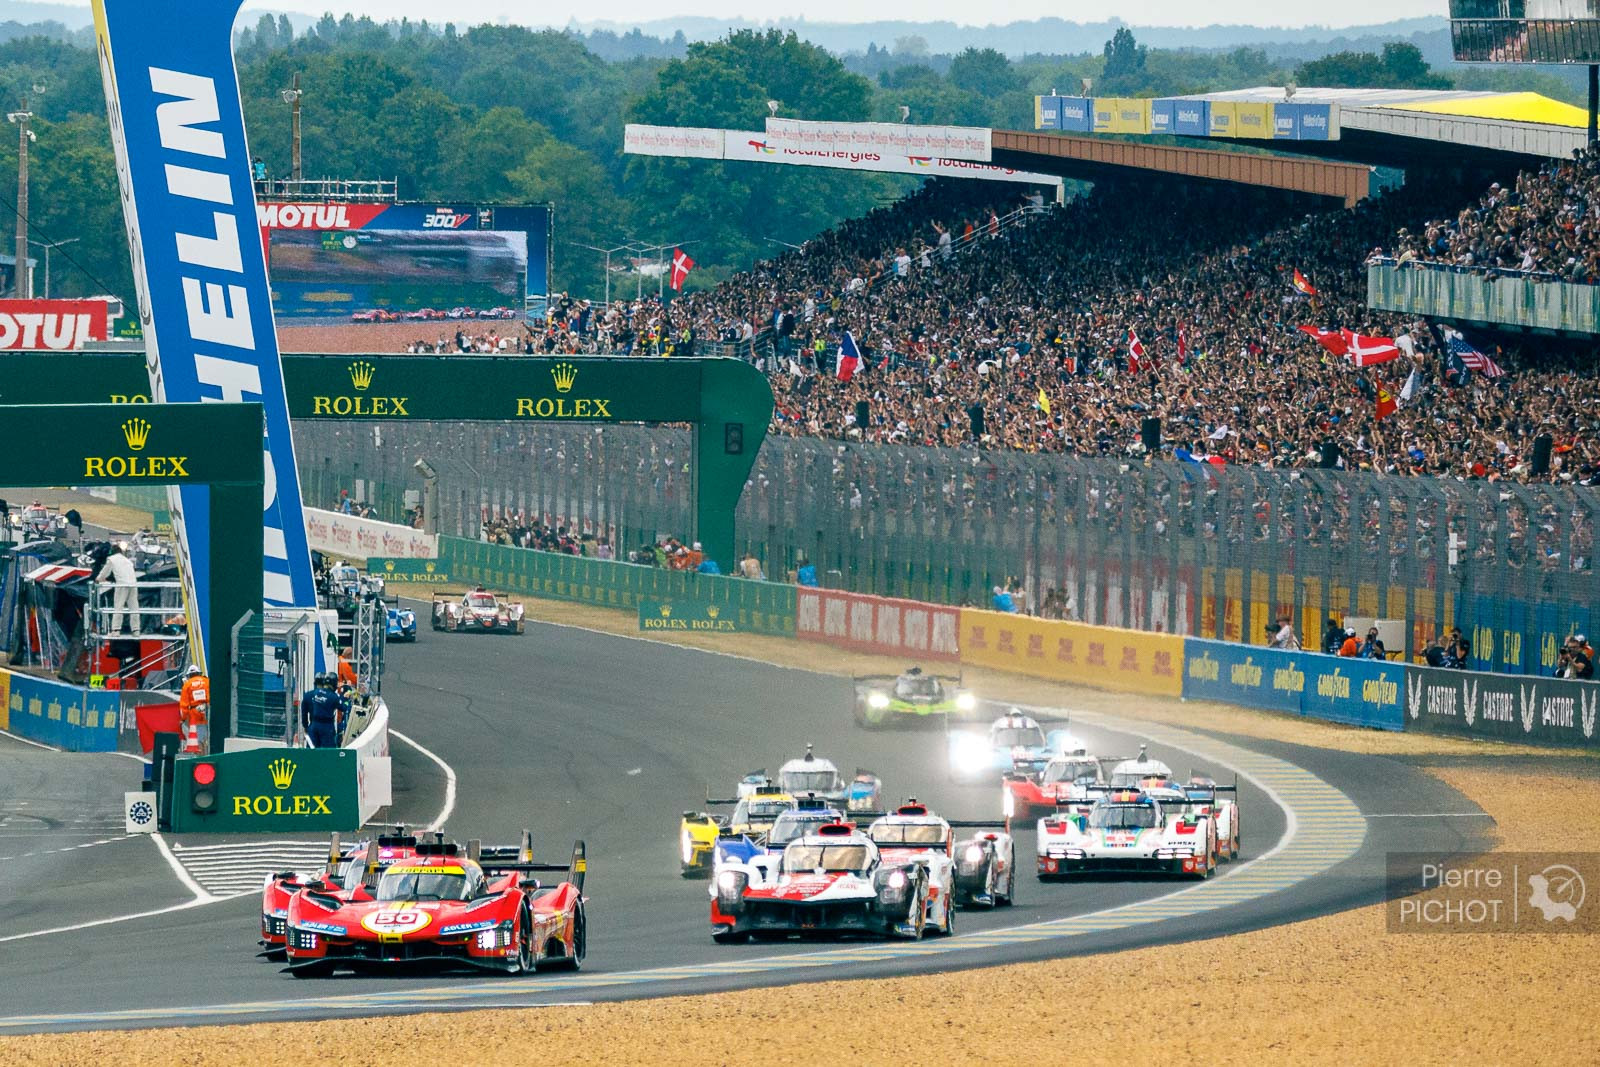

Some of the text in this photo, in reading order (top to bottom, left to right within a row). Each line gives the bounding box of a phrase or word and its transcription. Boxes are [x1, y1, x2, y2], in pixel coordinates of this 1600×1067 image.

[257, 204, 350, 228] MOTUL
[423, 214, 471, 228] 300V
[0, 312, 97, 349] OTUL
[148, 66, 295, 607] HELIN
[313, 397, 409, 416] ROLEX
[516, 398, 611, 417] ROLEX
[84, 456, 189, 477] ROLEX
[413, 574, 448, 582] ROLEX
[645, 618, 735, 631] ROLEX ROLEX
[1318, 667, 1350, 703] GOODYEAR
[1363, 673, 1398, 710] GOODYEAR
[1427, 685, 1574, 727] CASTORE CASTORE CASTORE
[233, 796, 332, 815] ROLEX
[375, 912, 418, 925] 50
[443, 923, 473, 932] ADLER
